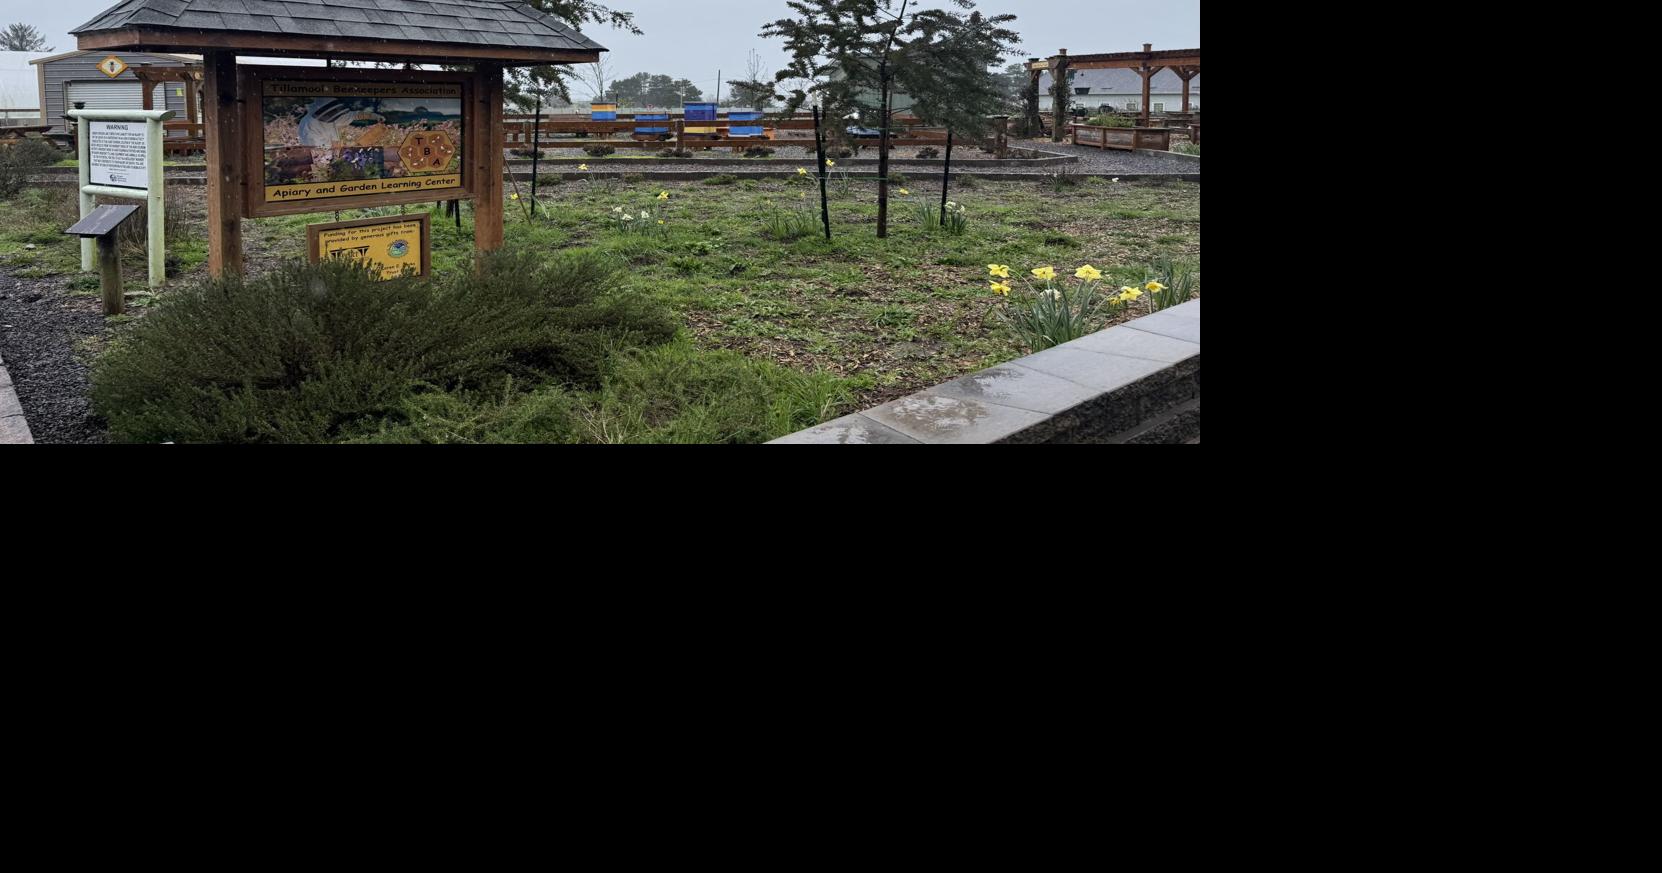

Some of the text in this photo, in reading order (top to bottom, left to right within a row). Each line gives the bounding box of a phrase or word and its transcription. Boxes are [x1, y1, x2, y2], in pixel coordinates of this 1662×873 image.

[273, 178, 456, 198] Apiary and Garden Learning Center
